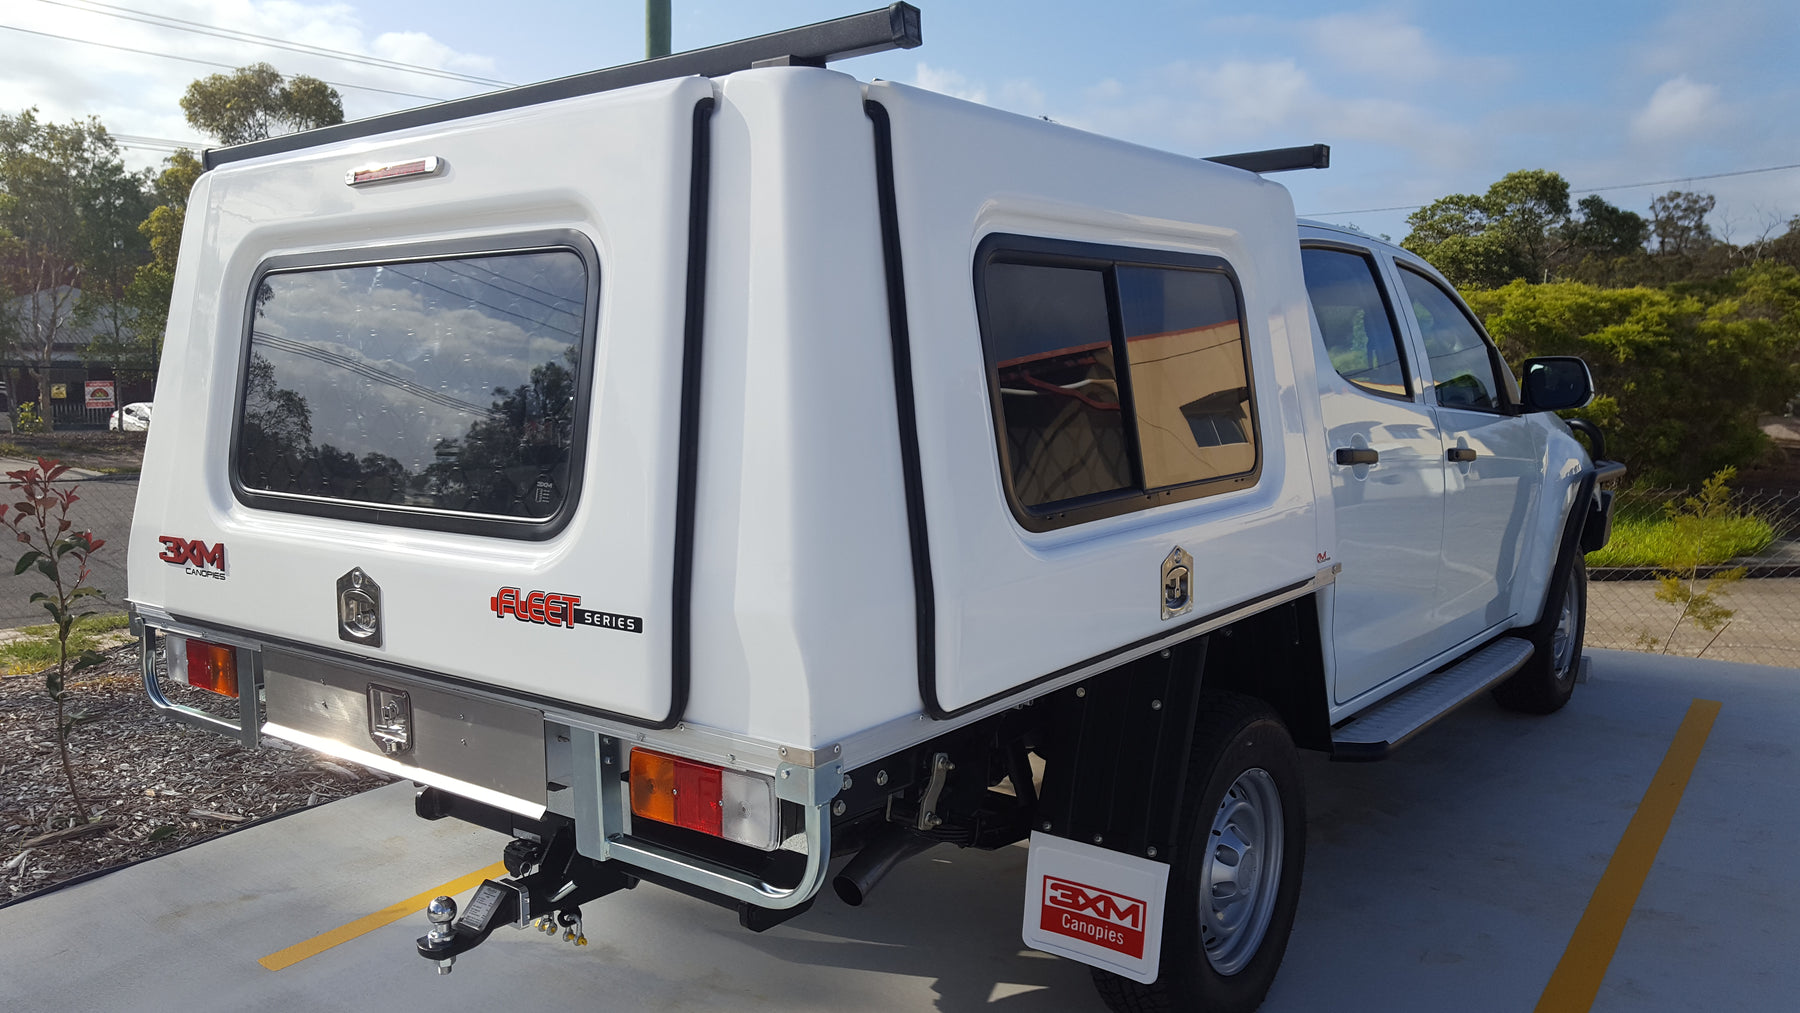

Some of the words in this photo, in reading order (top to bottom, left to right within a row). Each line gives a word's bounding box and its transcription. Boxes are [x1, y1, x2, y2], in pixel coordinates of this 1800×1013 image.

[159, 536, 225, 572] 3XM
[185, 567, 226, 580] CANOPIES
[497, 586, 581, 629] FLEET
[584, 612, 635, 630] SERIES
[1049, 882, 1140, 929] 3XM
[1062, 913, 1124, 945] Canopies
